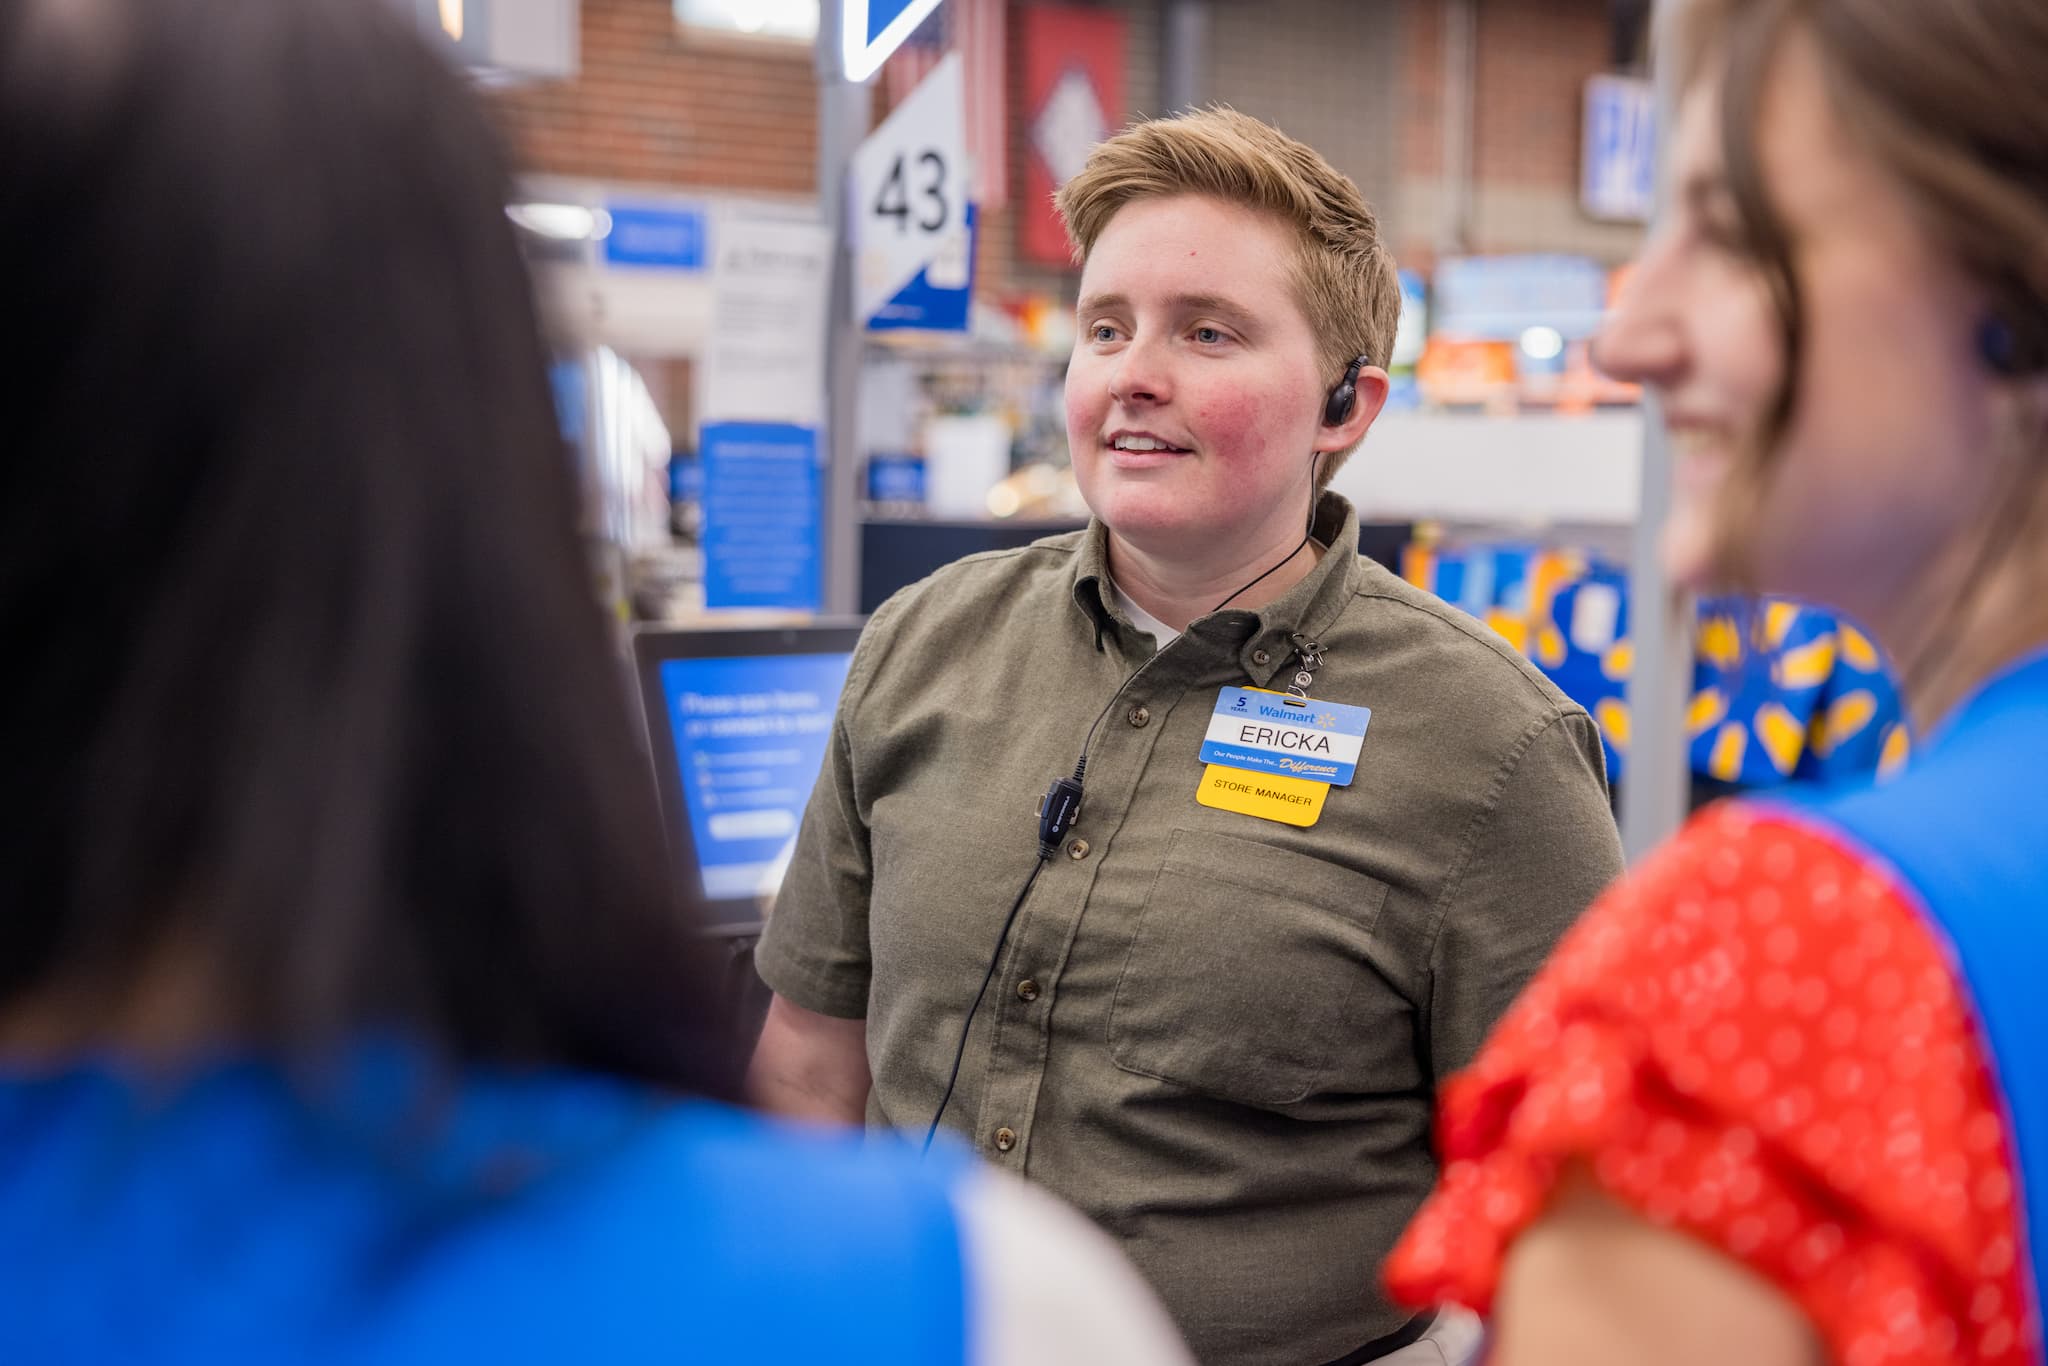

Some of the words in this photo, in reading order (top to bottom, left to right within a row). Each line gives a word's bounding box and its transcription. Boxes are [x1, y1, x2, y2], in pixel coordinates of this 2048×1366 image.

[874, 151, 948, 234] 43
[1237, 697, 1247, 706] 5
[1260, 705, 1315, 723] Walmart
[1239, 725, 1330, 753] ERICKA
[1226, 752, 1246, 761] People
[1247, 755, 1263, 764] Make
[1279, 757, 1338, 773] Difference
[1214, 779, 1253, 794] STORE
[1255, 787, 1312, 806] MANAGER
